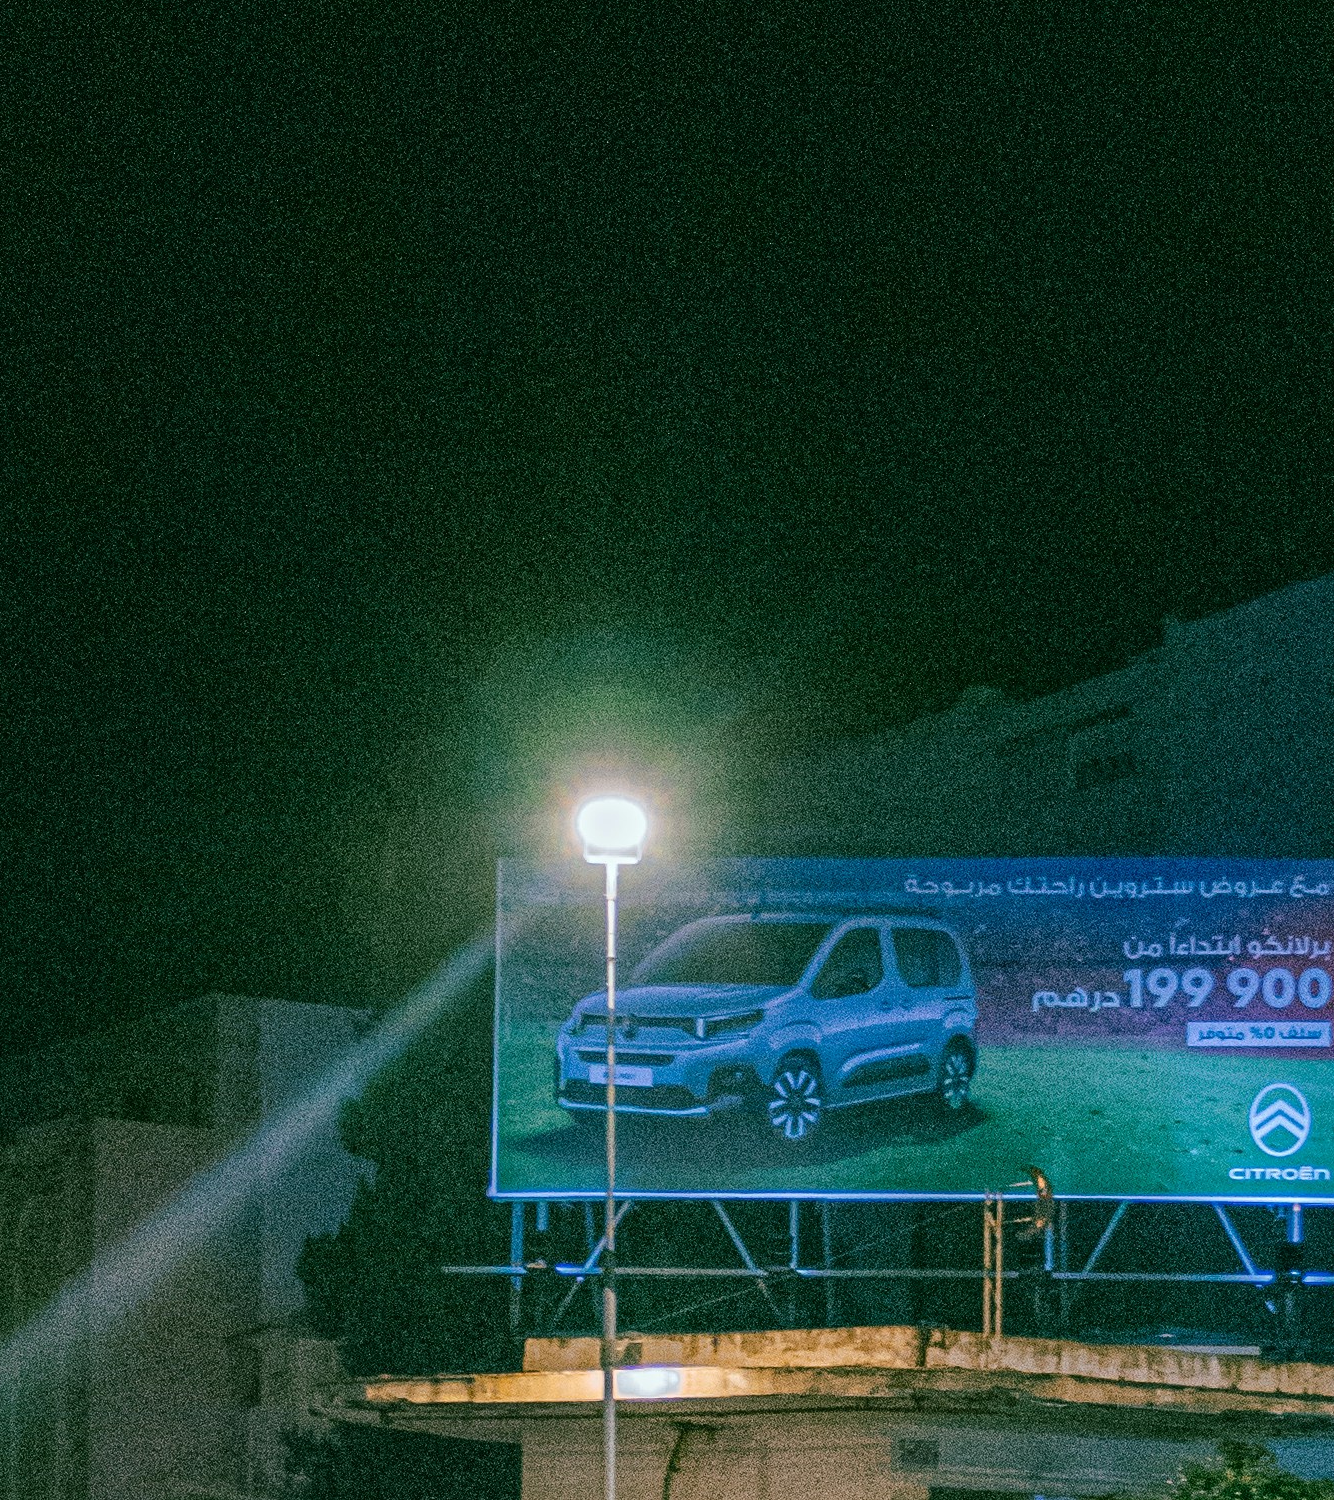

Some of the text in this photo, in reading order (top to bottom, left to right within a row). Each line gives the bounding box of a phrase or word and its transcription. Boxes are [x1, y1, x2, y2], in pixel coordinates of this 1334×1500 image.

[1007, 876, 1084, 898] راحتك
[1088, 876, 1195, 899] ستروين
[1199, 876, 1284, 898] عروض
[1289, 875, 1330, 898] مع
[1123, 935, 1163, 959] من
[1031, 967, 1333, 1012] 199 900 درهم
